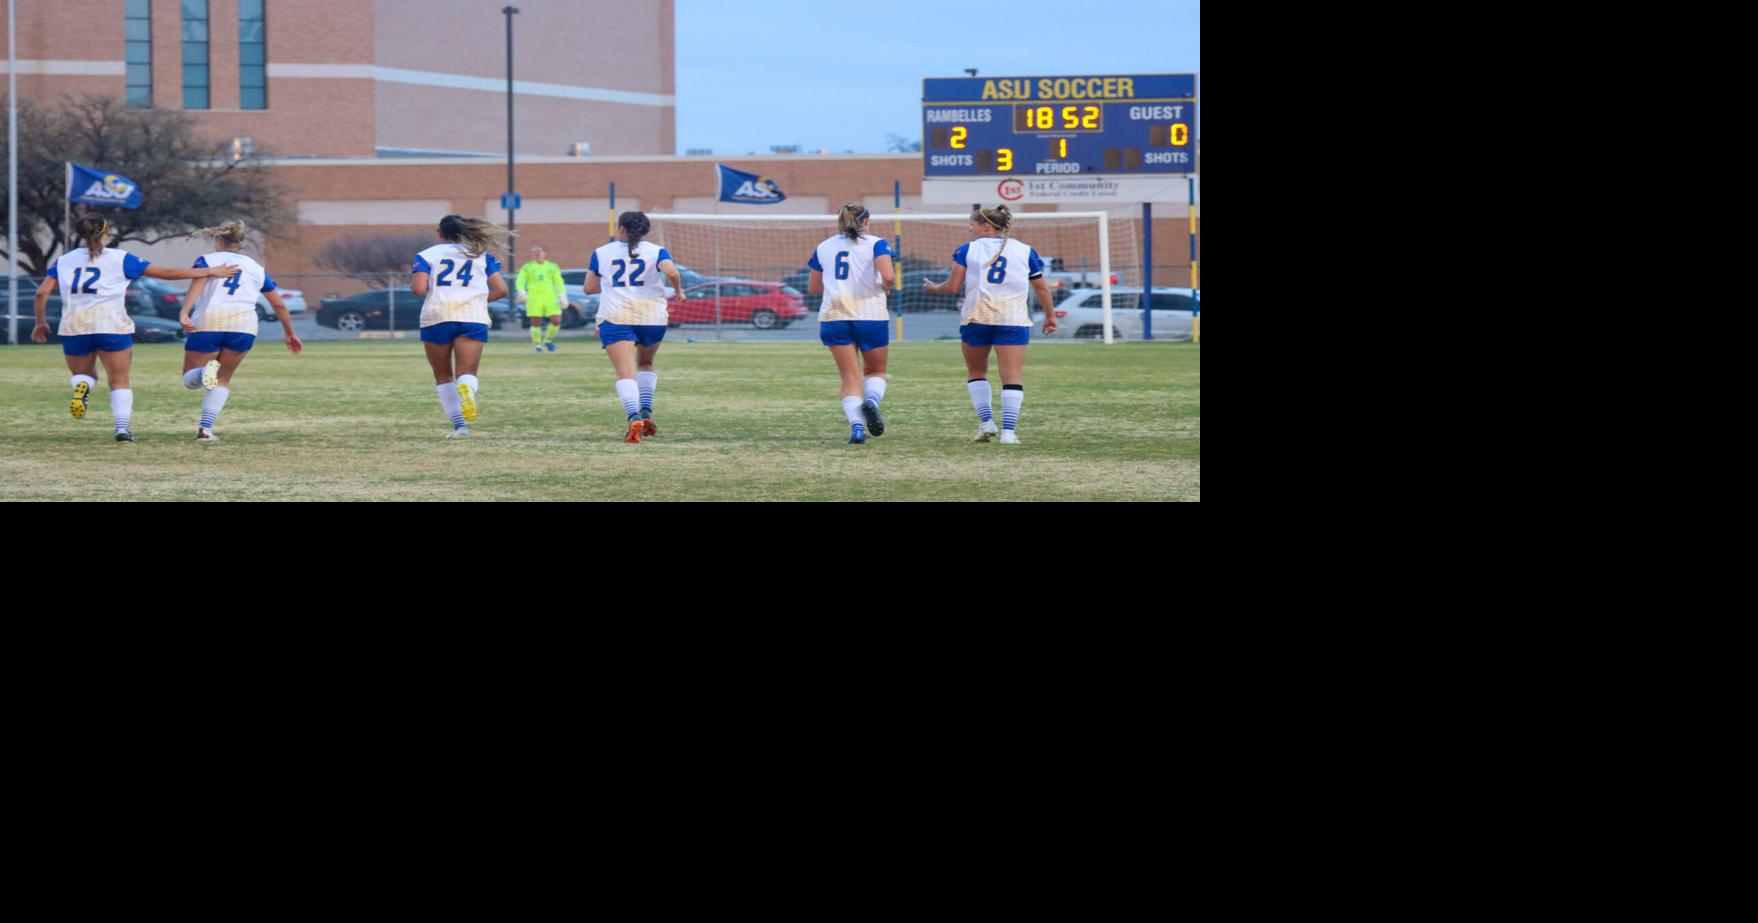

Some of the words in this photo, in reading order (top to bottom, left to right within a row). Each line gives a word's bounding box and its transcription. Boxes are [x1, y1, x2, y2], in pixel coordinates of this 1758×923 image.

[981, 80, 1030, 100] ASU
[1038, 77, 1135, 99] SOCCER
[926, 109, 992, 123] RAMBELLES
[1129, 105, 1184, 120] GUEST
[950, 126, 968, 149] 2
[1170, 123, 1188, 146] 0
[997, 148, 1013, 171] 3
[1059, 138, 1067, 158] 1
[1144, 152, 1189, 164] SHOTS
[930, 154, 974, 167] SHOTS
[1036, 162, 1080, 174] PERIOD
[1049, 179, 1118, 191] Community
[436, 258, 474, 288] 24
[611, 259, 647, 288] 22
[834, 251, 850, 281] 6
[986, 255, 1008, 285] 8
[70, 266, 101, 295] 12
[222, 269, 242, 295] 4
